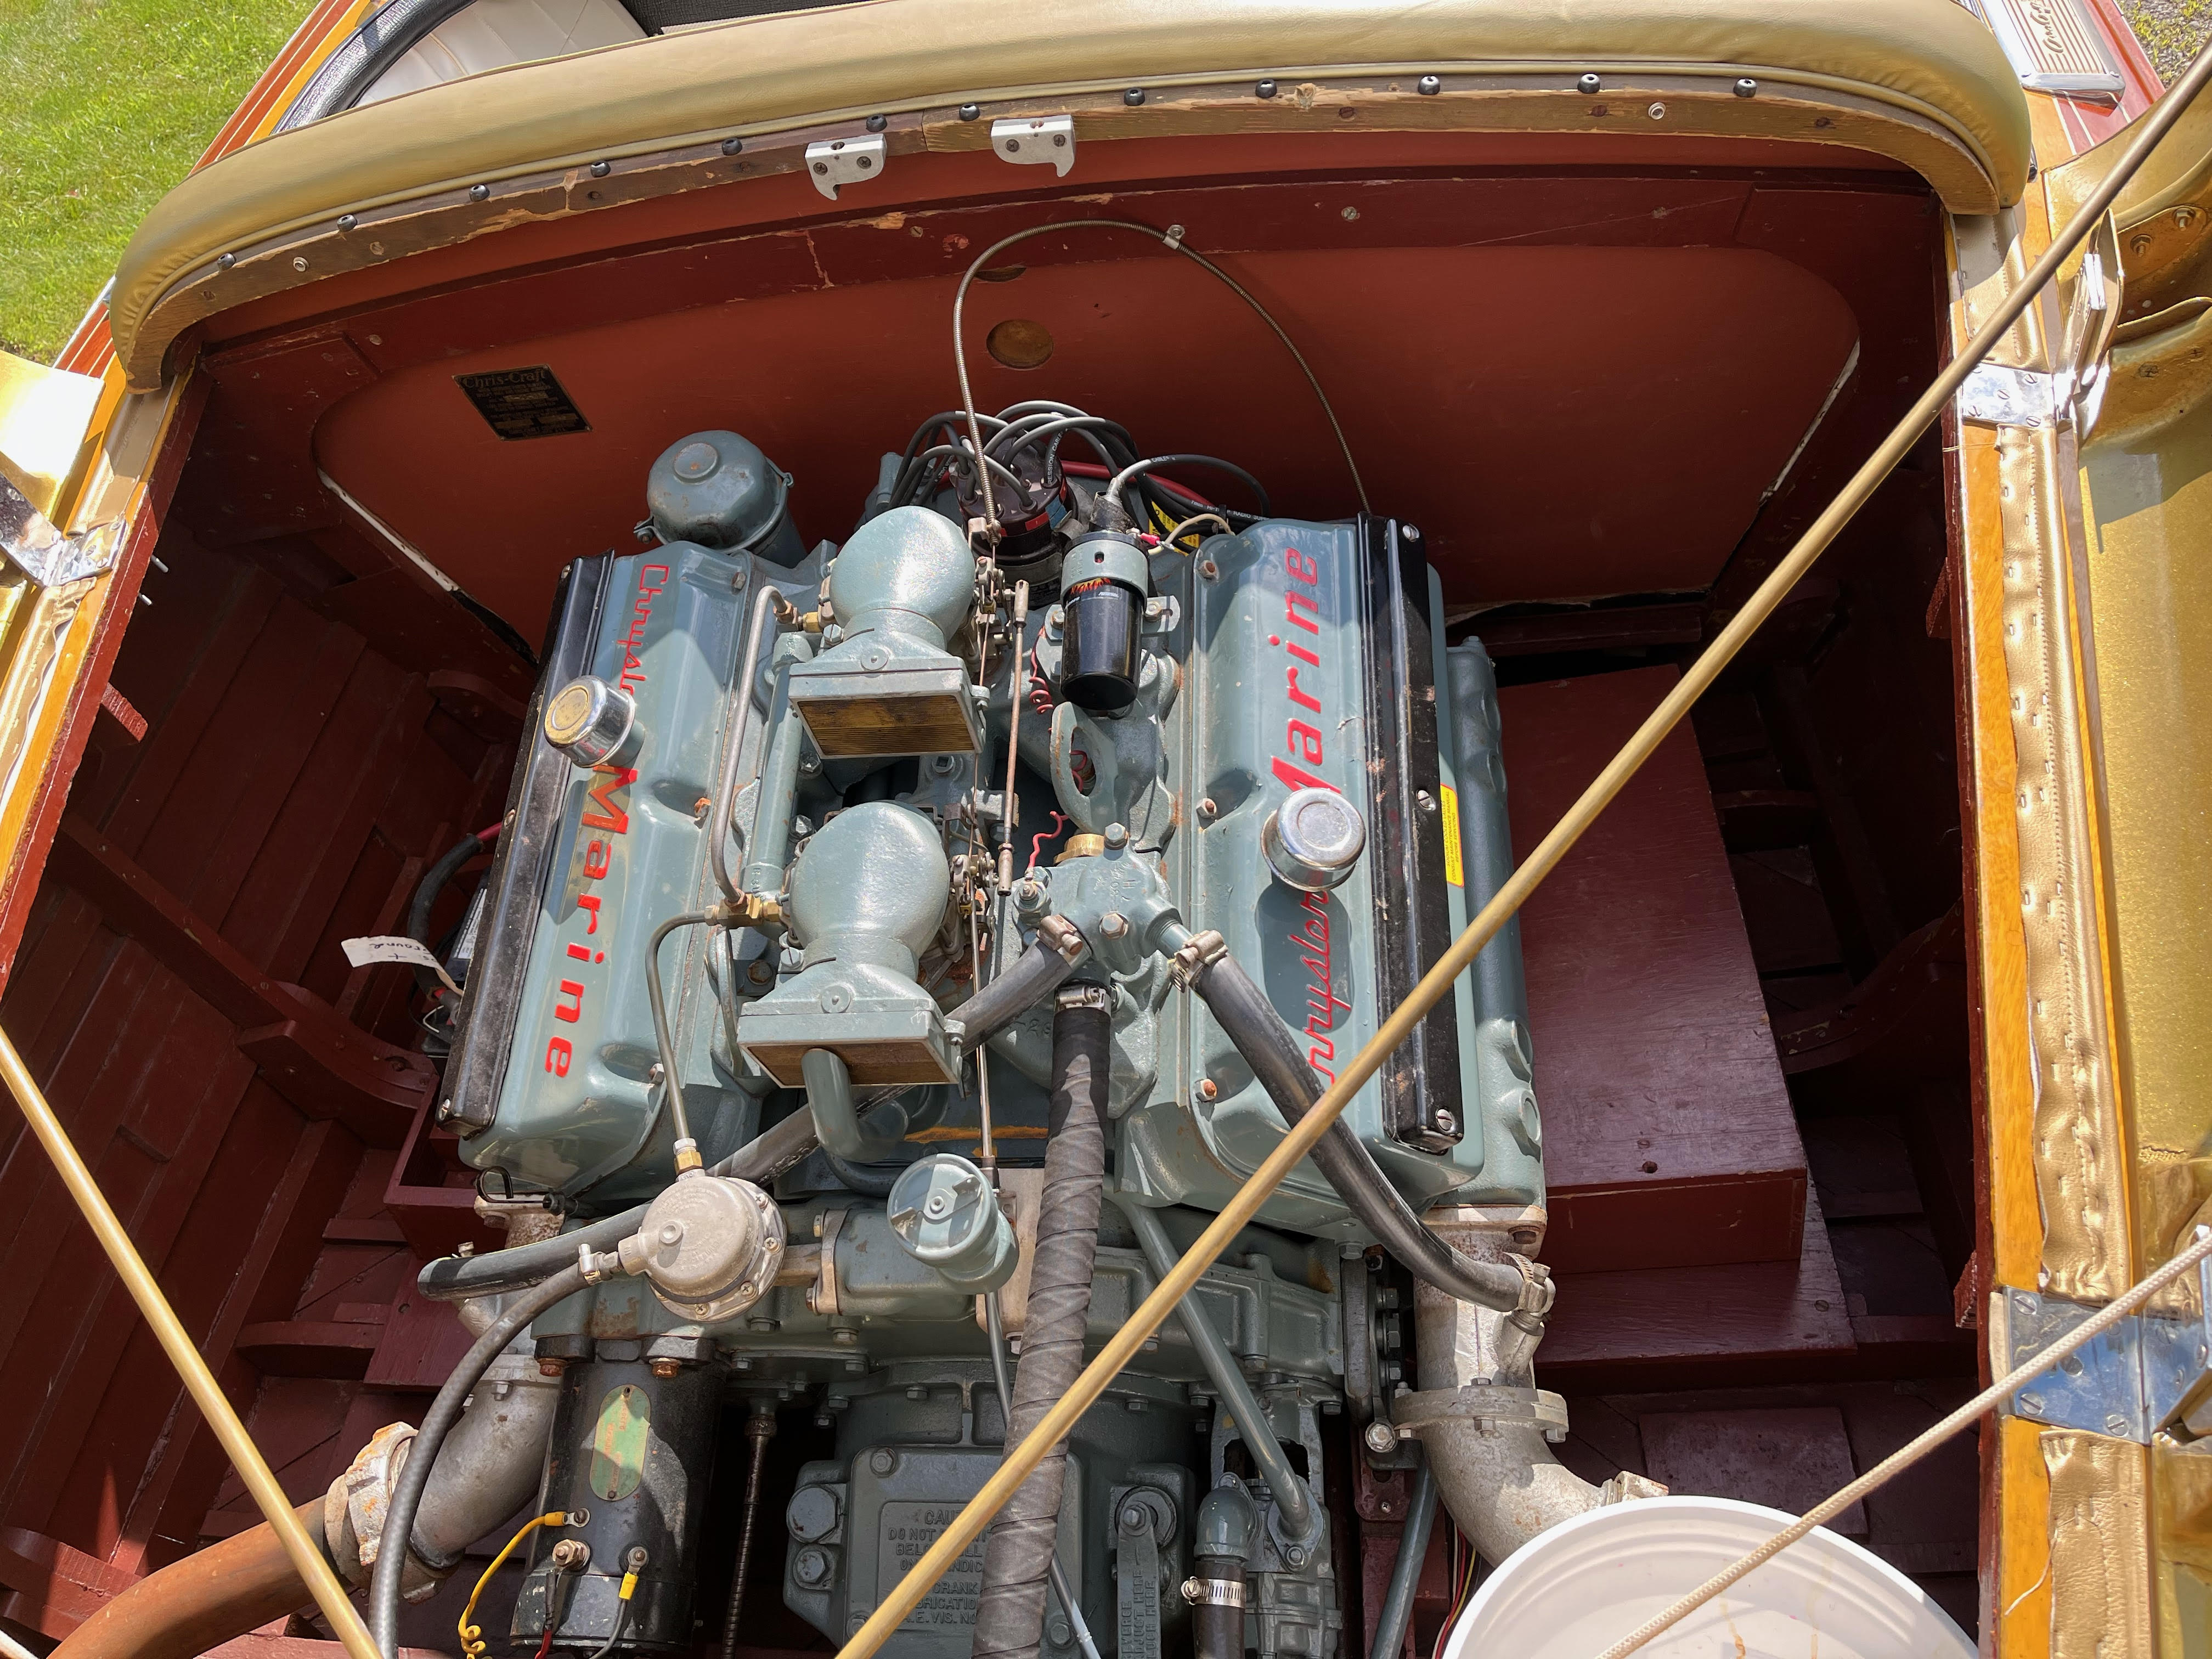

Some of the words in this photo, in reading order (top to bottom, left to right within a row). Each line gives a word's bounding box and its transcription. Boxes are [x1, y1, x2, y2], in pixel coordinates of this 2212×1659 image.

[462, 369, 546, 388] Chris-Craft
[1233, 511, 1251, 519] RADIO
[613, 565, 669, 696] Chrysl
[545, 764, 639, 1078] Marine
[888, 1528, 906, 1541] DO
[909, 1528, 936, 1541] NOT
[1133, 1570, 1144, 1604] HERE
[930, 1612, 957, 1624] VIS.
